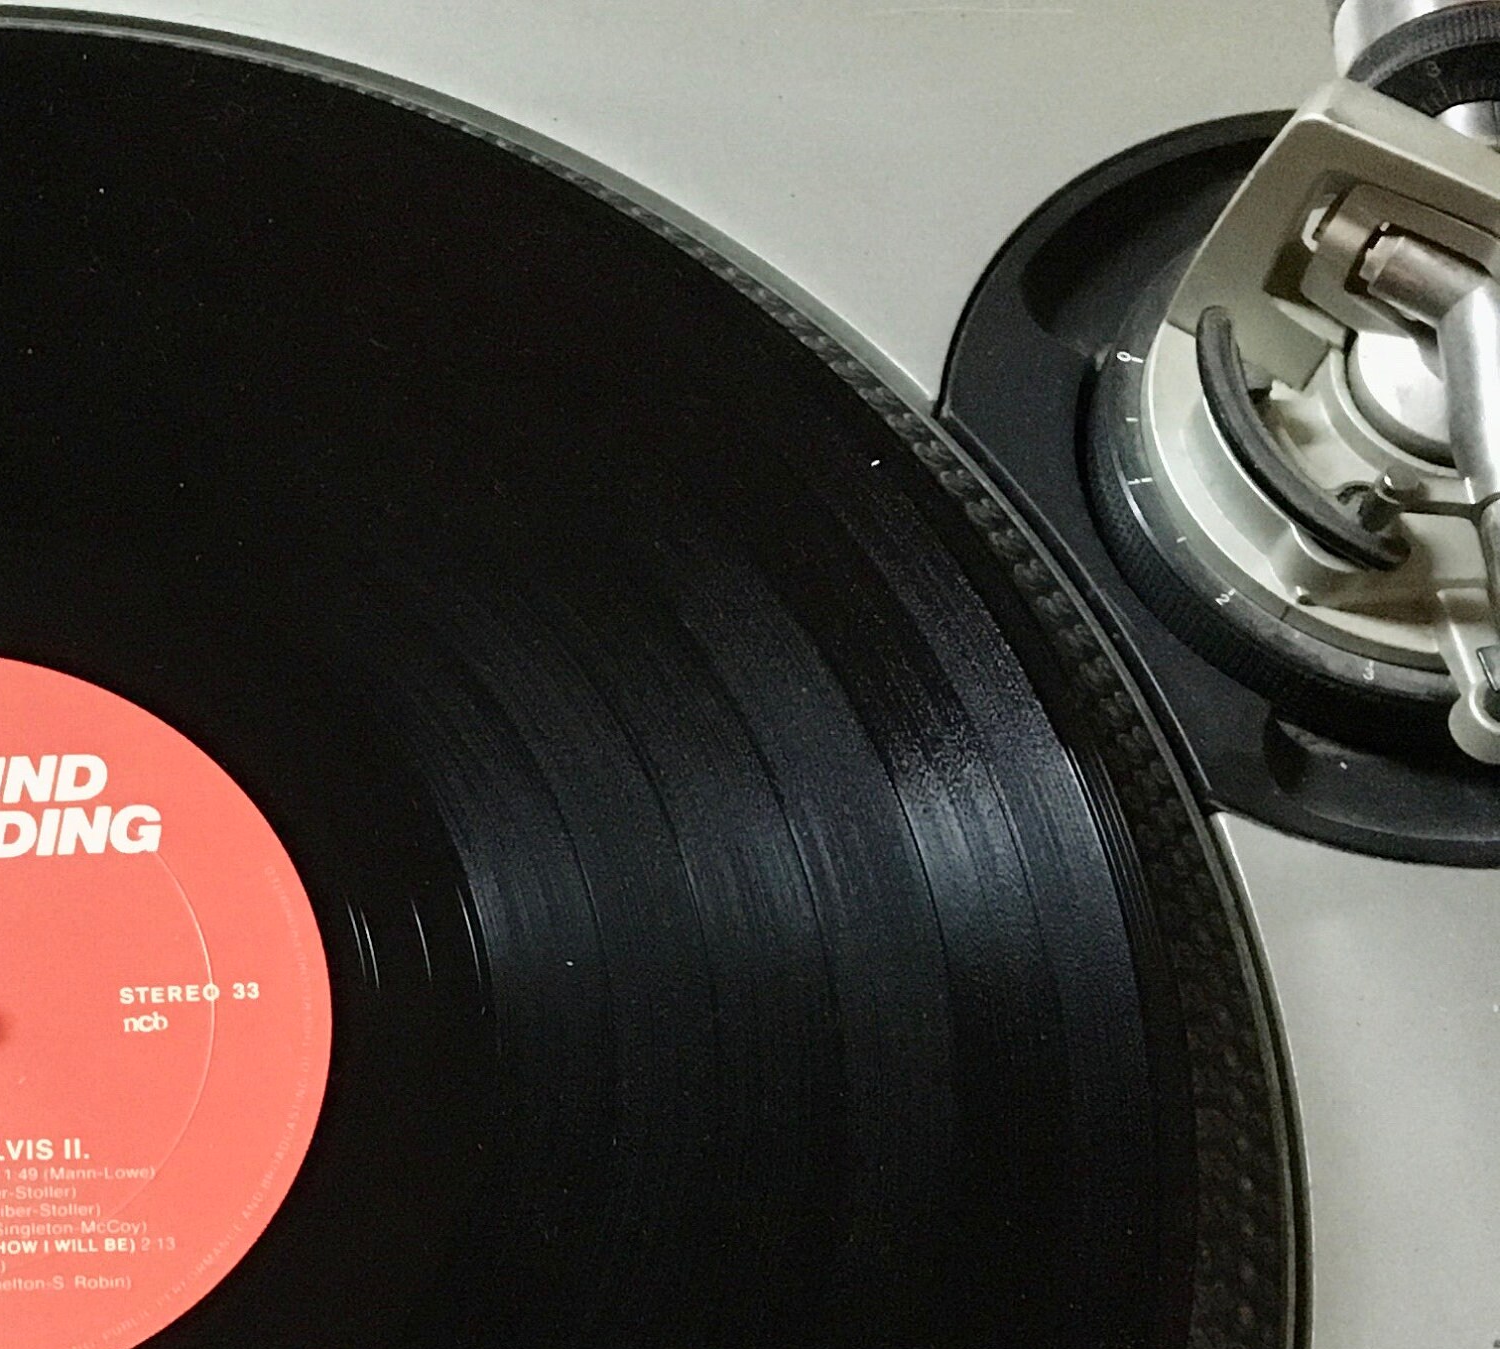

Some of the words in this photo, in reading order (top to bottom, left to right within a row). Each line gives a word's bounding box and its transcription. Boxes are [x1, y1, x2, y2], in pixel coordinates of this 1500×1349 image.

[1215, 594, 1230, 606] 2
[1363, 667, 1375, 681] 3
[118, 982, 221, 1006] STEREO
[231, 980, 261, 1000] 33
[64, 1138, 90, 1160] II.
[43, 1166, 156, 1182] (Mann-Lowe)
[43, 1240, 49, 1253] I
[54, 1239, 98, 1253] WILL
[104, 1237, 136, 1253] BE)
[74, 1275, 131, 1289] Robin)
